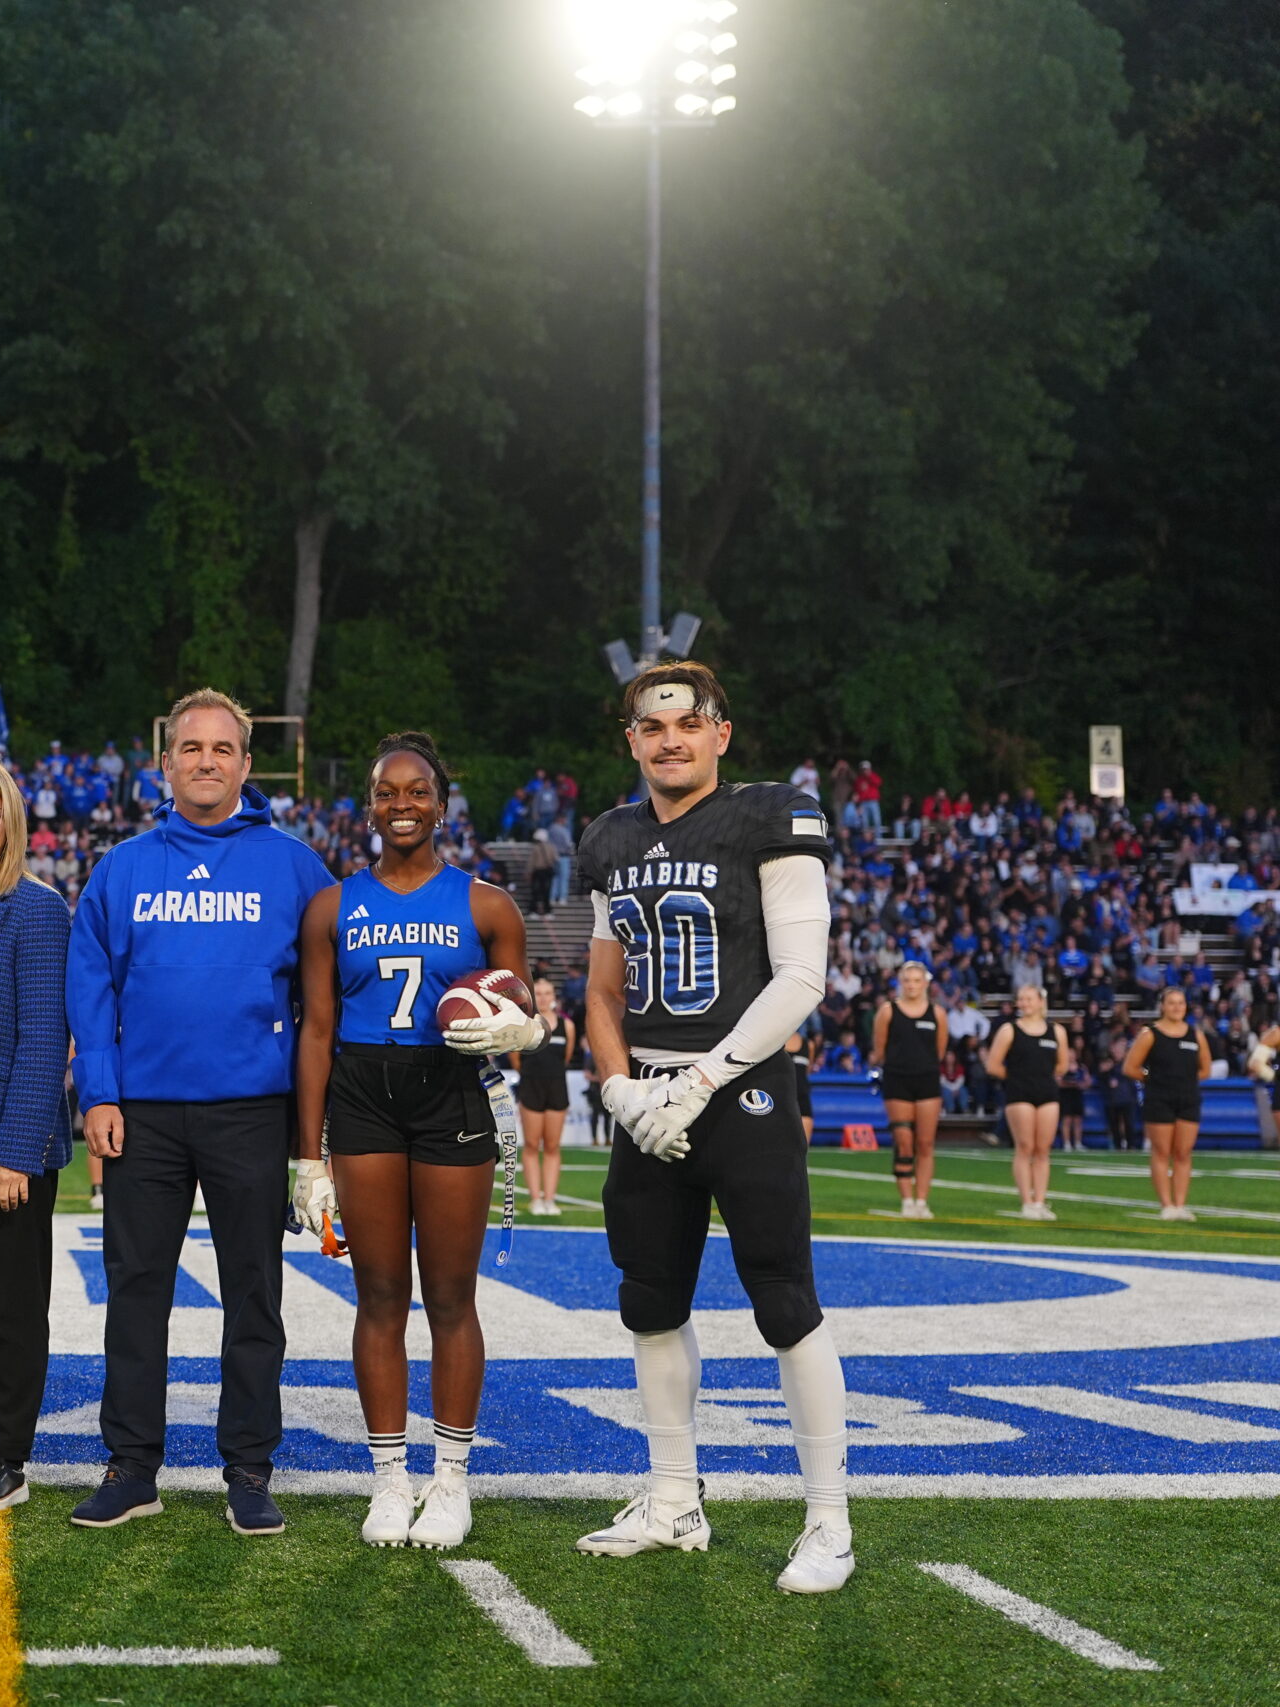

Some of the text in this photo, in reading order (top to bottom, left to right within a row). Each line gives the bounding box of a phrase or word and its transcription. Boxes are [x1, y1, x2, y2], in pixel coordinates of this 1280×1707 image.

[1100, 739, 1113, 757] 4
[643, 851, 670, 860] adidas
[132, 890, 261, 923] CARABINS
[346, 923, 460, 952] CARABINS
[377, 955, 424, 1030] 7
[500, 1131, 518, 1230] CARABINS
[673, 1507, 702, 1539] NIKE
